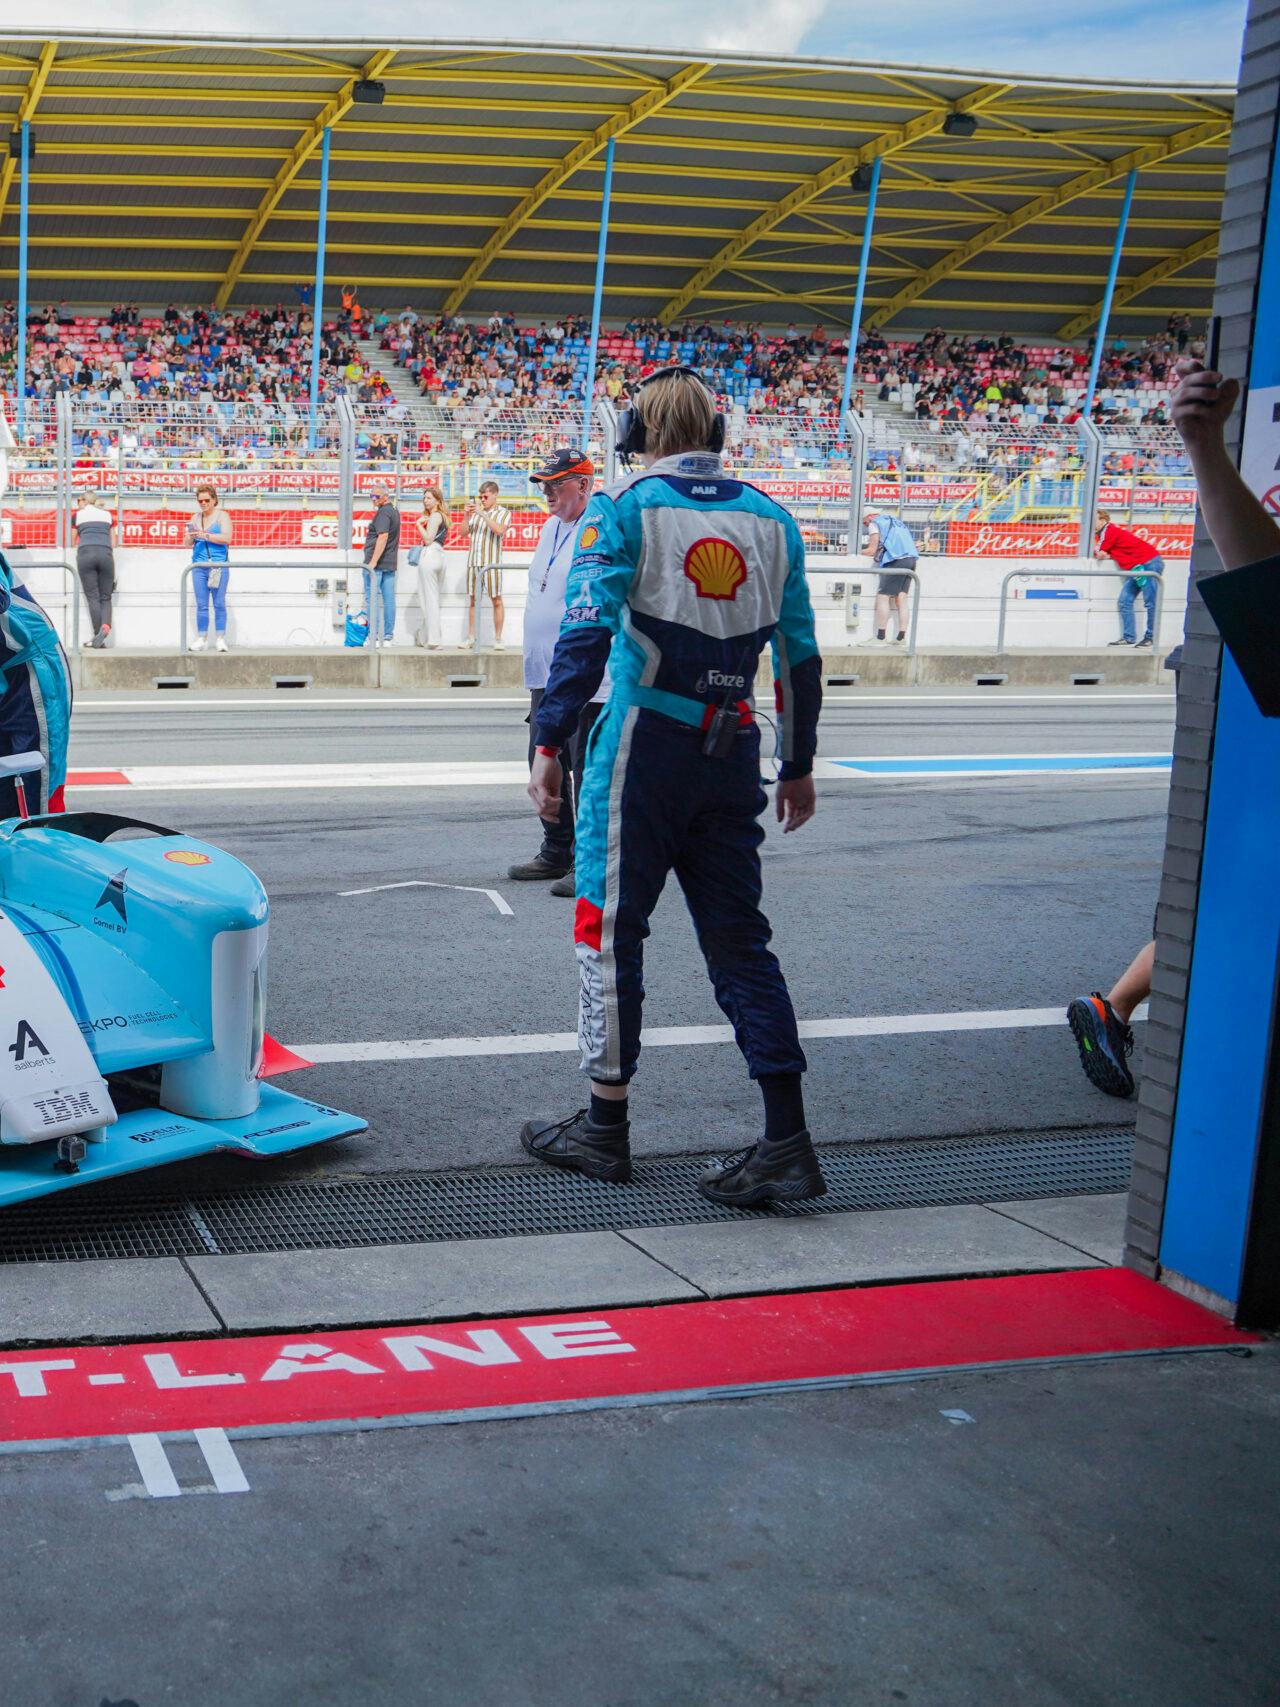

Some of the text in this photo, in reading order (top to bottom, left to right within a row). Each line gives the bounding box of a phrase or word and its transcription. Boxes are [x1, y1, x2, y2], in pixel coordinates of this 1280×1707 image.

[70, 471, 99, 482] ACK'S
[150, 474, 185, 484] JACK'S
[193, 474, 228, 484] JACK'S
[276, 475, 312, 485] JACK'S
[800, 484, 831, 493] JACK'S
[910, 487, 940, 496] JACK'S
[149, 521, 178, 537] die
[522, 524, 542, 538] di
[708, 670, 745, 688] Forze
[77, 1016, 128, 1034] EKPO
[14, 1057, 56, 1071] aalberts
[32, 1091, 100, 1125] IBM
